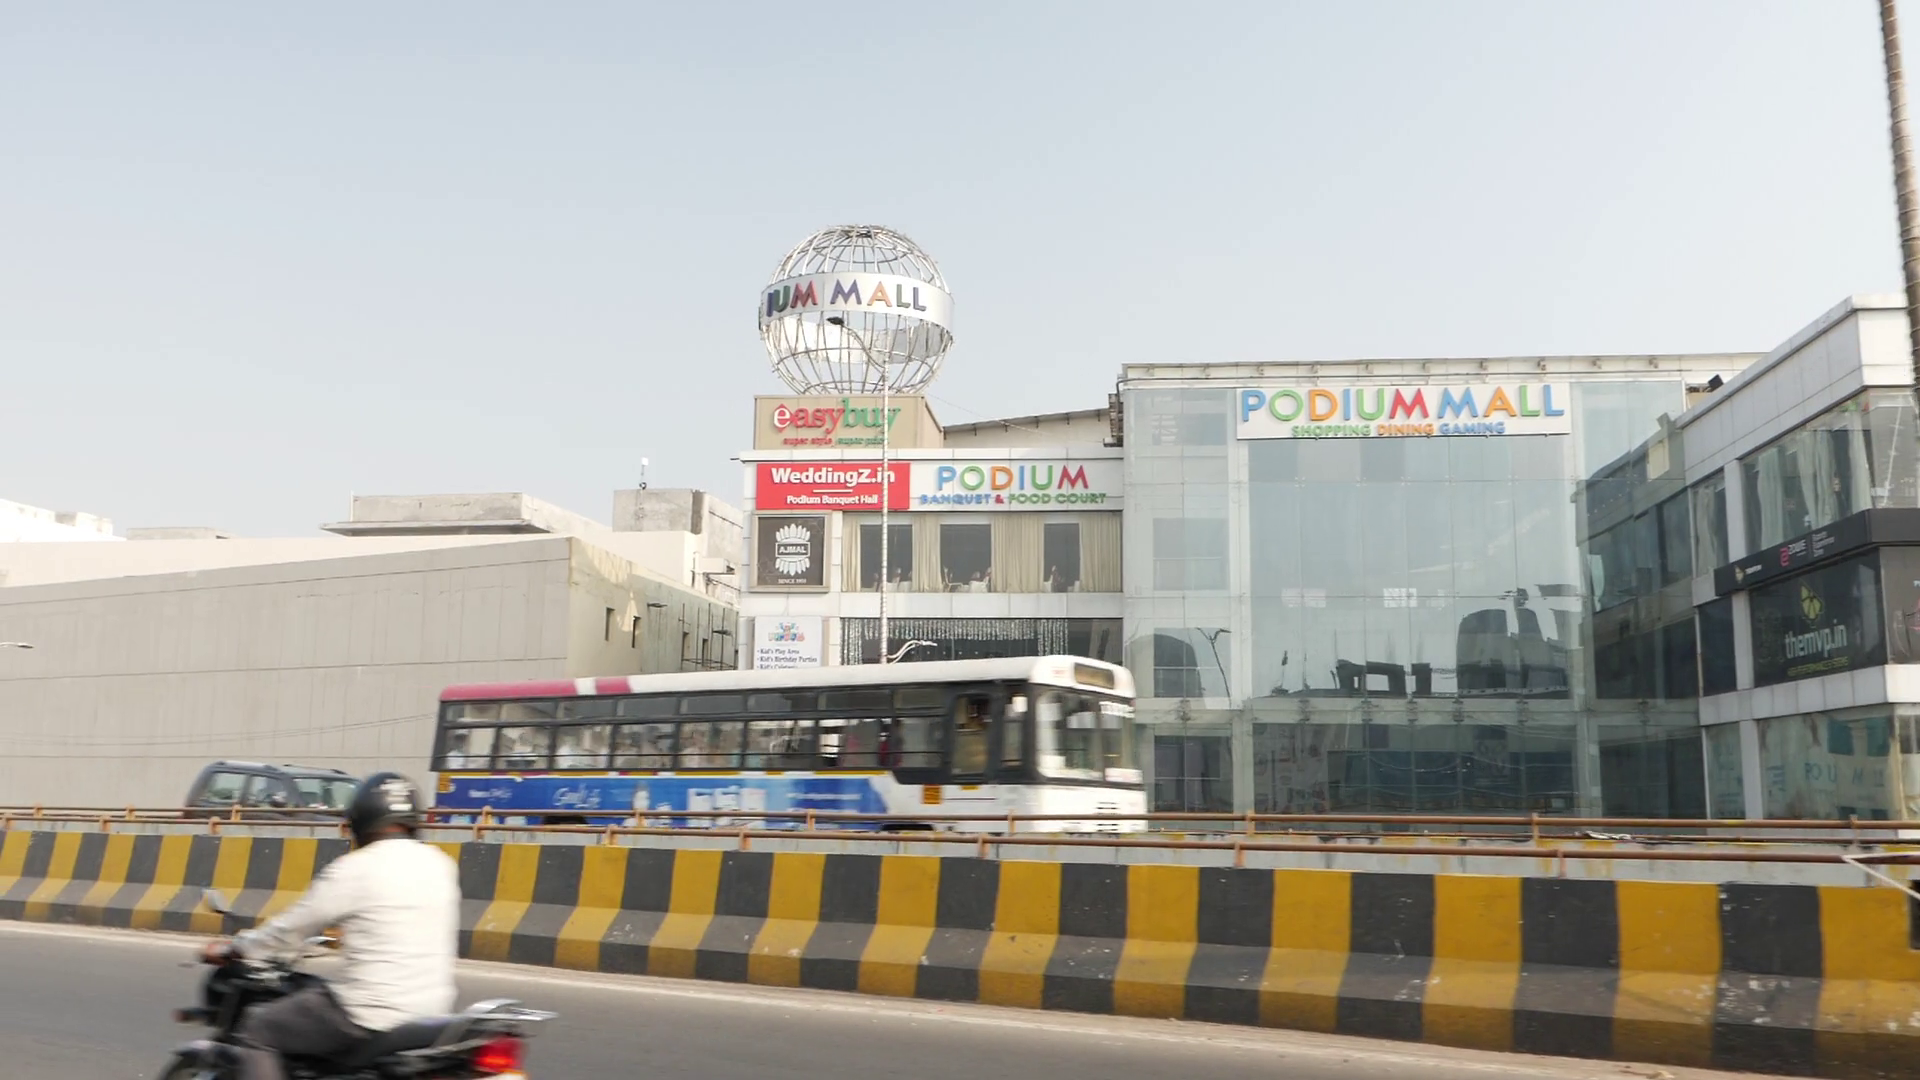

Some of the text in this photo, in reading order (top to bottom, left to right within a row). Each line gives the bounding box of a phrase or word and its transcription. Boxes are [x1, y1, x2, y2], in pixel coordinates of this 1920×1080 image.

[830, 279, 927, 312] MALL
[1241, 384, 1565, 422] PODIUM MALL
[1291, 421, 1506, 437] SHOPPING DINING GAMING
[771, 467, 895, 487] WeddingZ.in
[937, 465, 1089, 491] PODIUM
[787, 495, 878, 505] Podium Banquet Hall
[919, 493, 1107, 505] BANQUET & FOOD COURT
[779, 545, 807, 553] AJMAL
